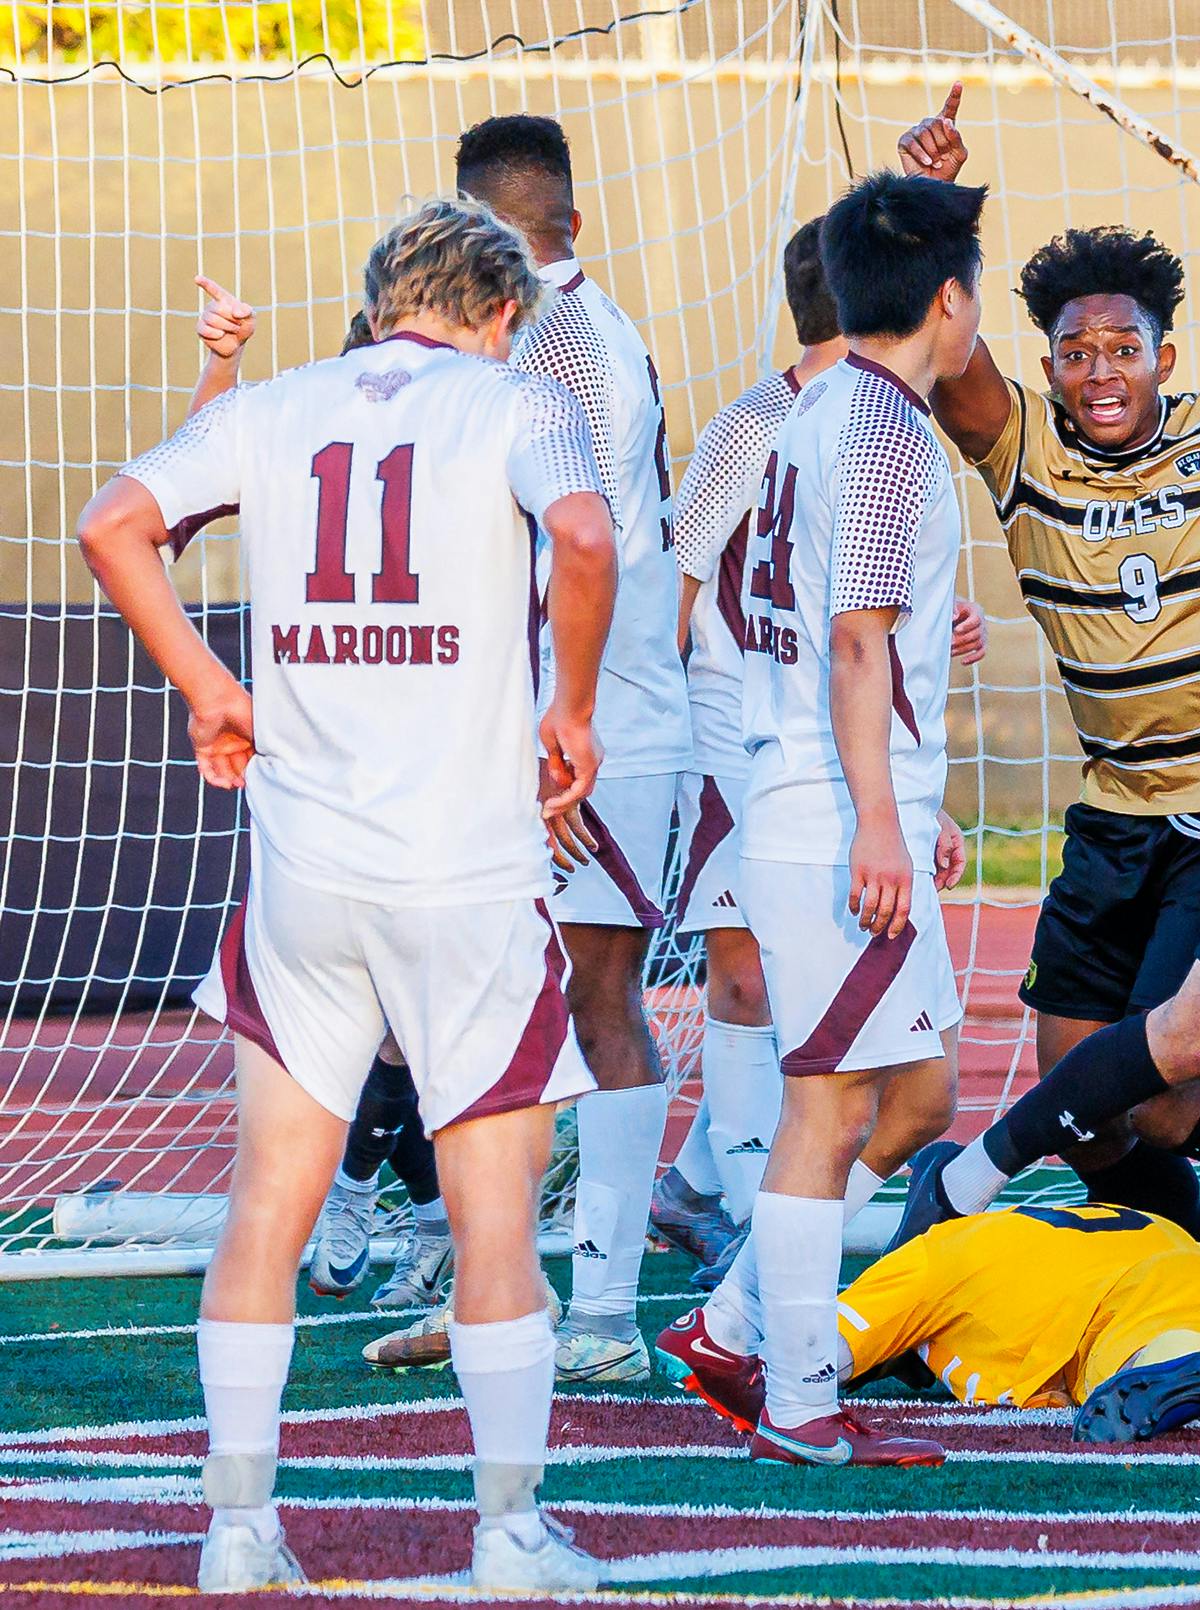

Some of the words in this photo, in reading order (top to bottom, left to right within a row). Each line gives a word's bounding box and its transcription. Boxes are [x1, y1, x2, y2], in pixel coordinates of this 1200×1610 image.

[305, 442, 420, 605] 11
[1082, 484, 1188, 543] OLES
[1118, 552, 1163, 625] 9
[271, 624, 461, 665] MAROONS
